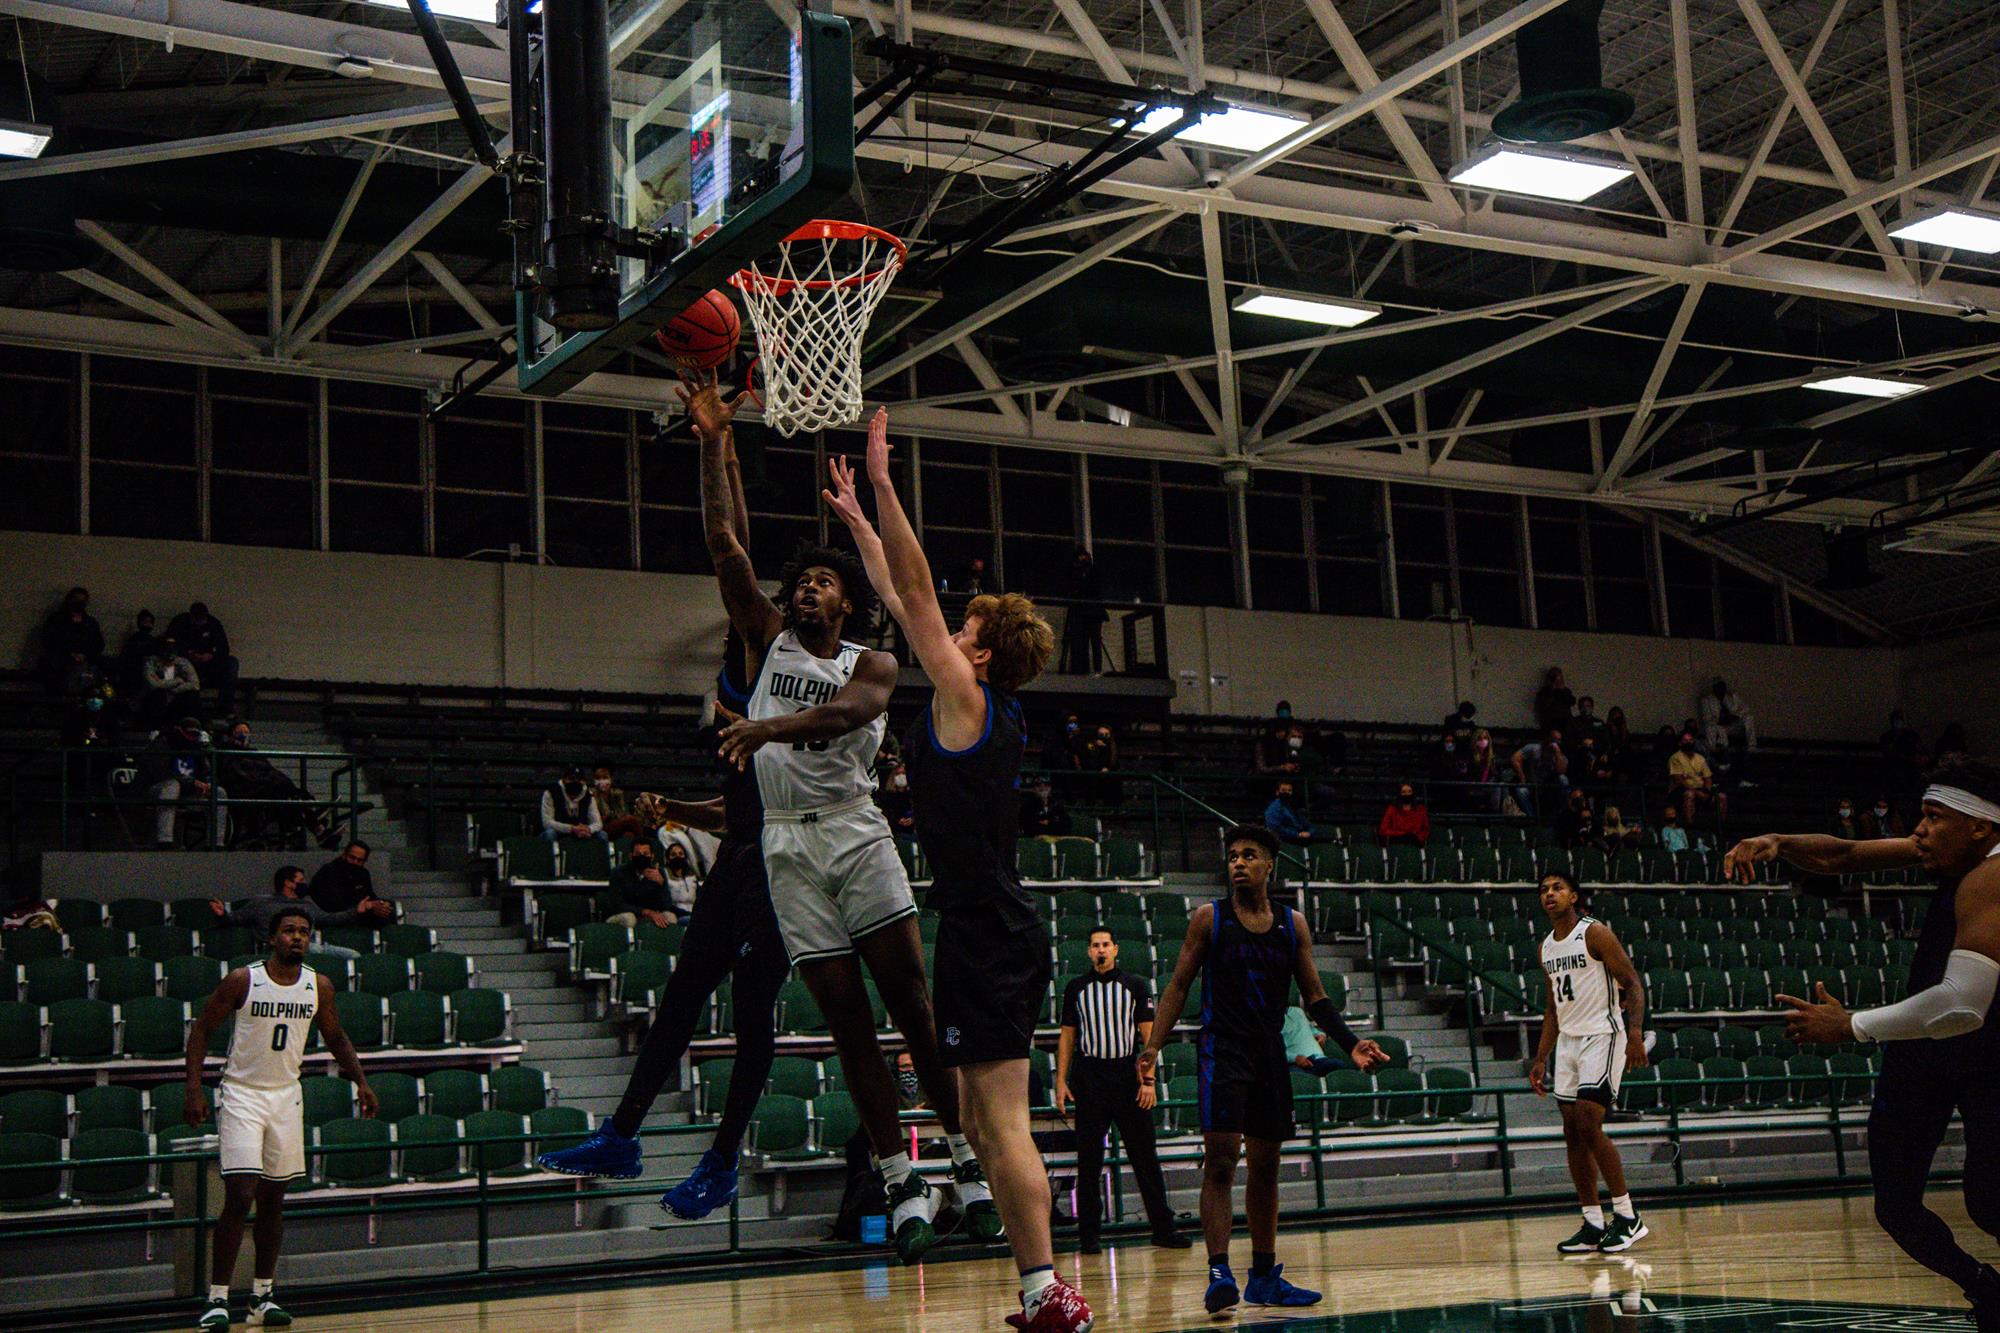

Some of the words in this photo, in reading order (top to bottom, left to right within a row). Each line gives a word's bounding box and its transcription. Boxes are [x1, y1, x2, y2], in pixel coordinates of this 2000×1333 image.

[770, 672, 843, 704] DOLPHI
[801, 812, 818, 823] JU
[1544, 954, 1587, 975] OLPHINS
[1556, 974, 1575, 1002] 14
[251, 1001, 314, 1019] DOLPHINS
[272, 1024, 288, 1051] 0
